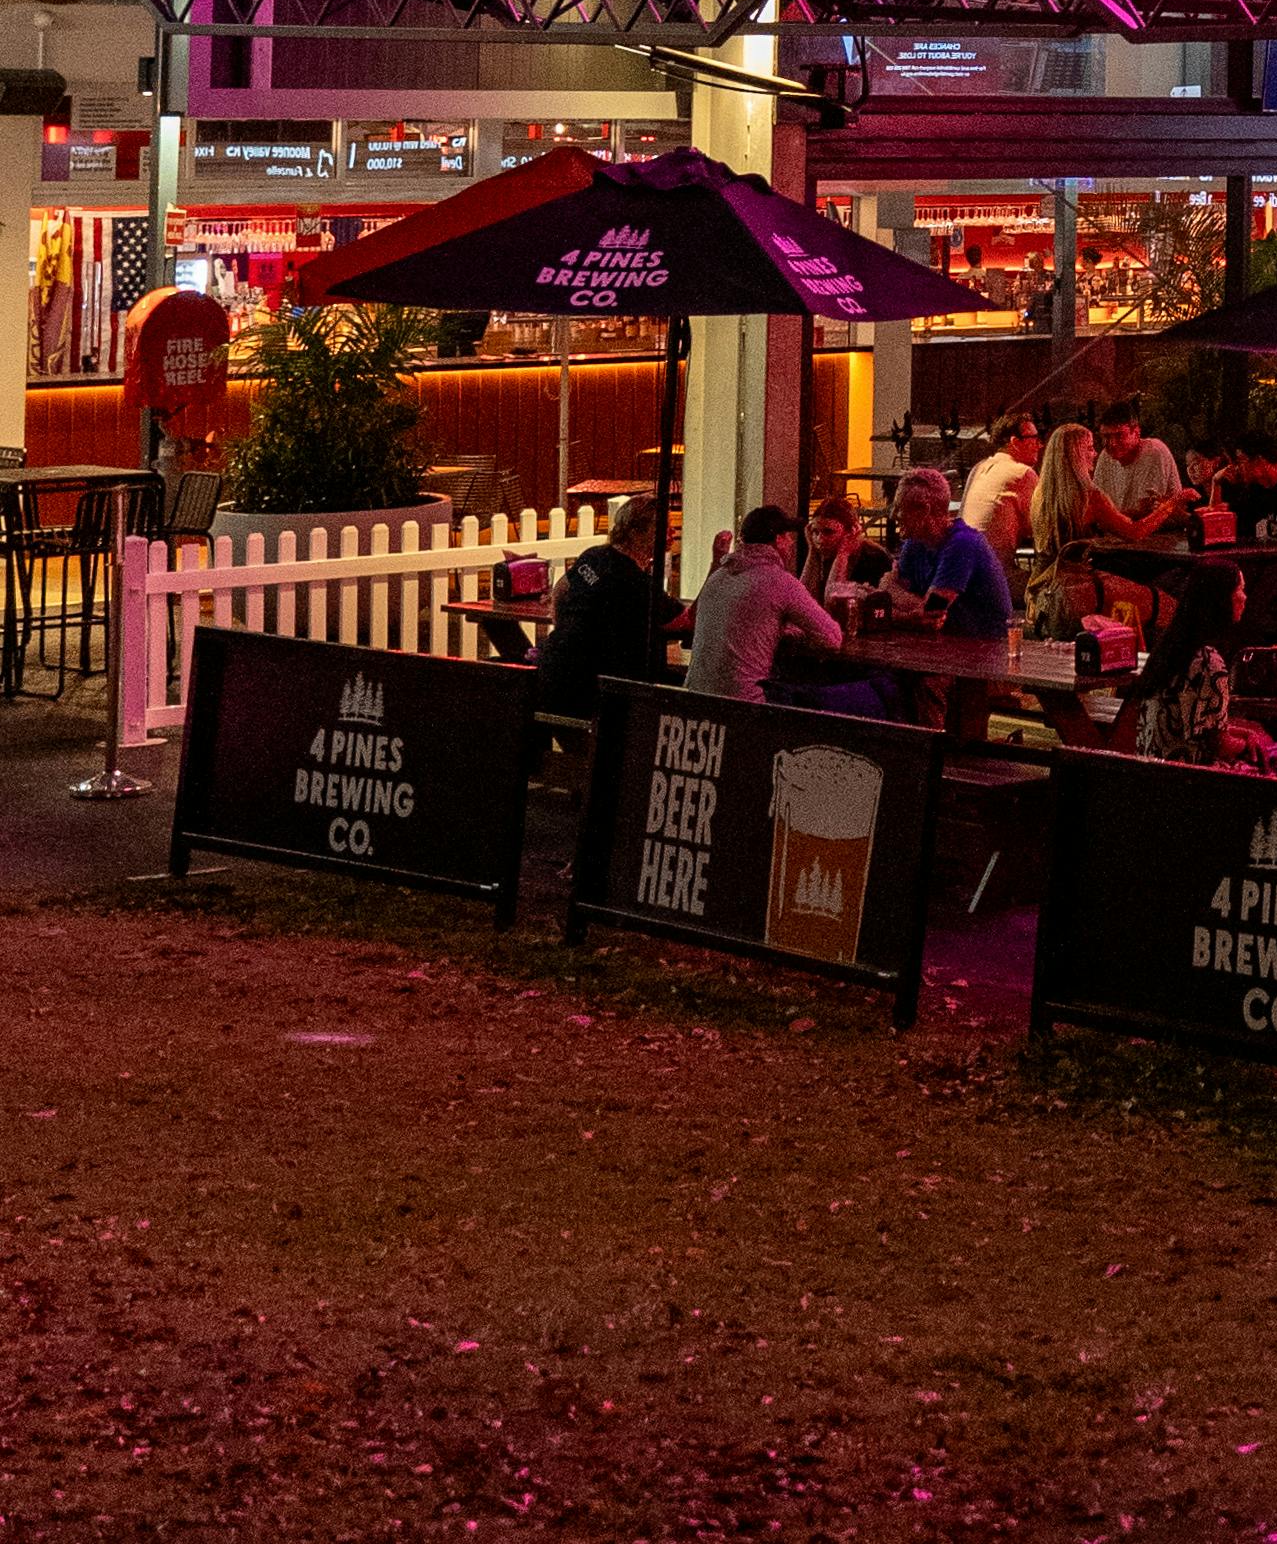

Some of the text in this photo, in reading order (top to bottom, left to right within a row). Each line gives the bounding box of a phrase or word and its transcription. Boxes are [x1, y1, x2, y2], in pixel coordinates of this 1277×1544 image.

[535, 267, 670, 288] BREWING
[561, 249, 665, 268] 4 PINES
[569, 290, 619, 307] CO.
[163, 353, 210, 370] HOSE
[166, 338, 204, 354] FIRE
[164, 369, 207, 386] REEL
[309, 727, 403, 773] 4 PINES
[654, 714, 726, 778] FRESH
[293, 768, 415, 818] BREWING
[647, 778, 716, 846] BEER
[328, 815, 373, 857] CO.
[637, 843, 709, 917] HERE
[1210, 877, 1230, 918] 4
